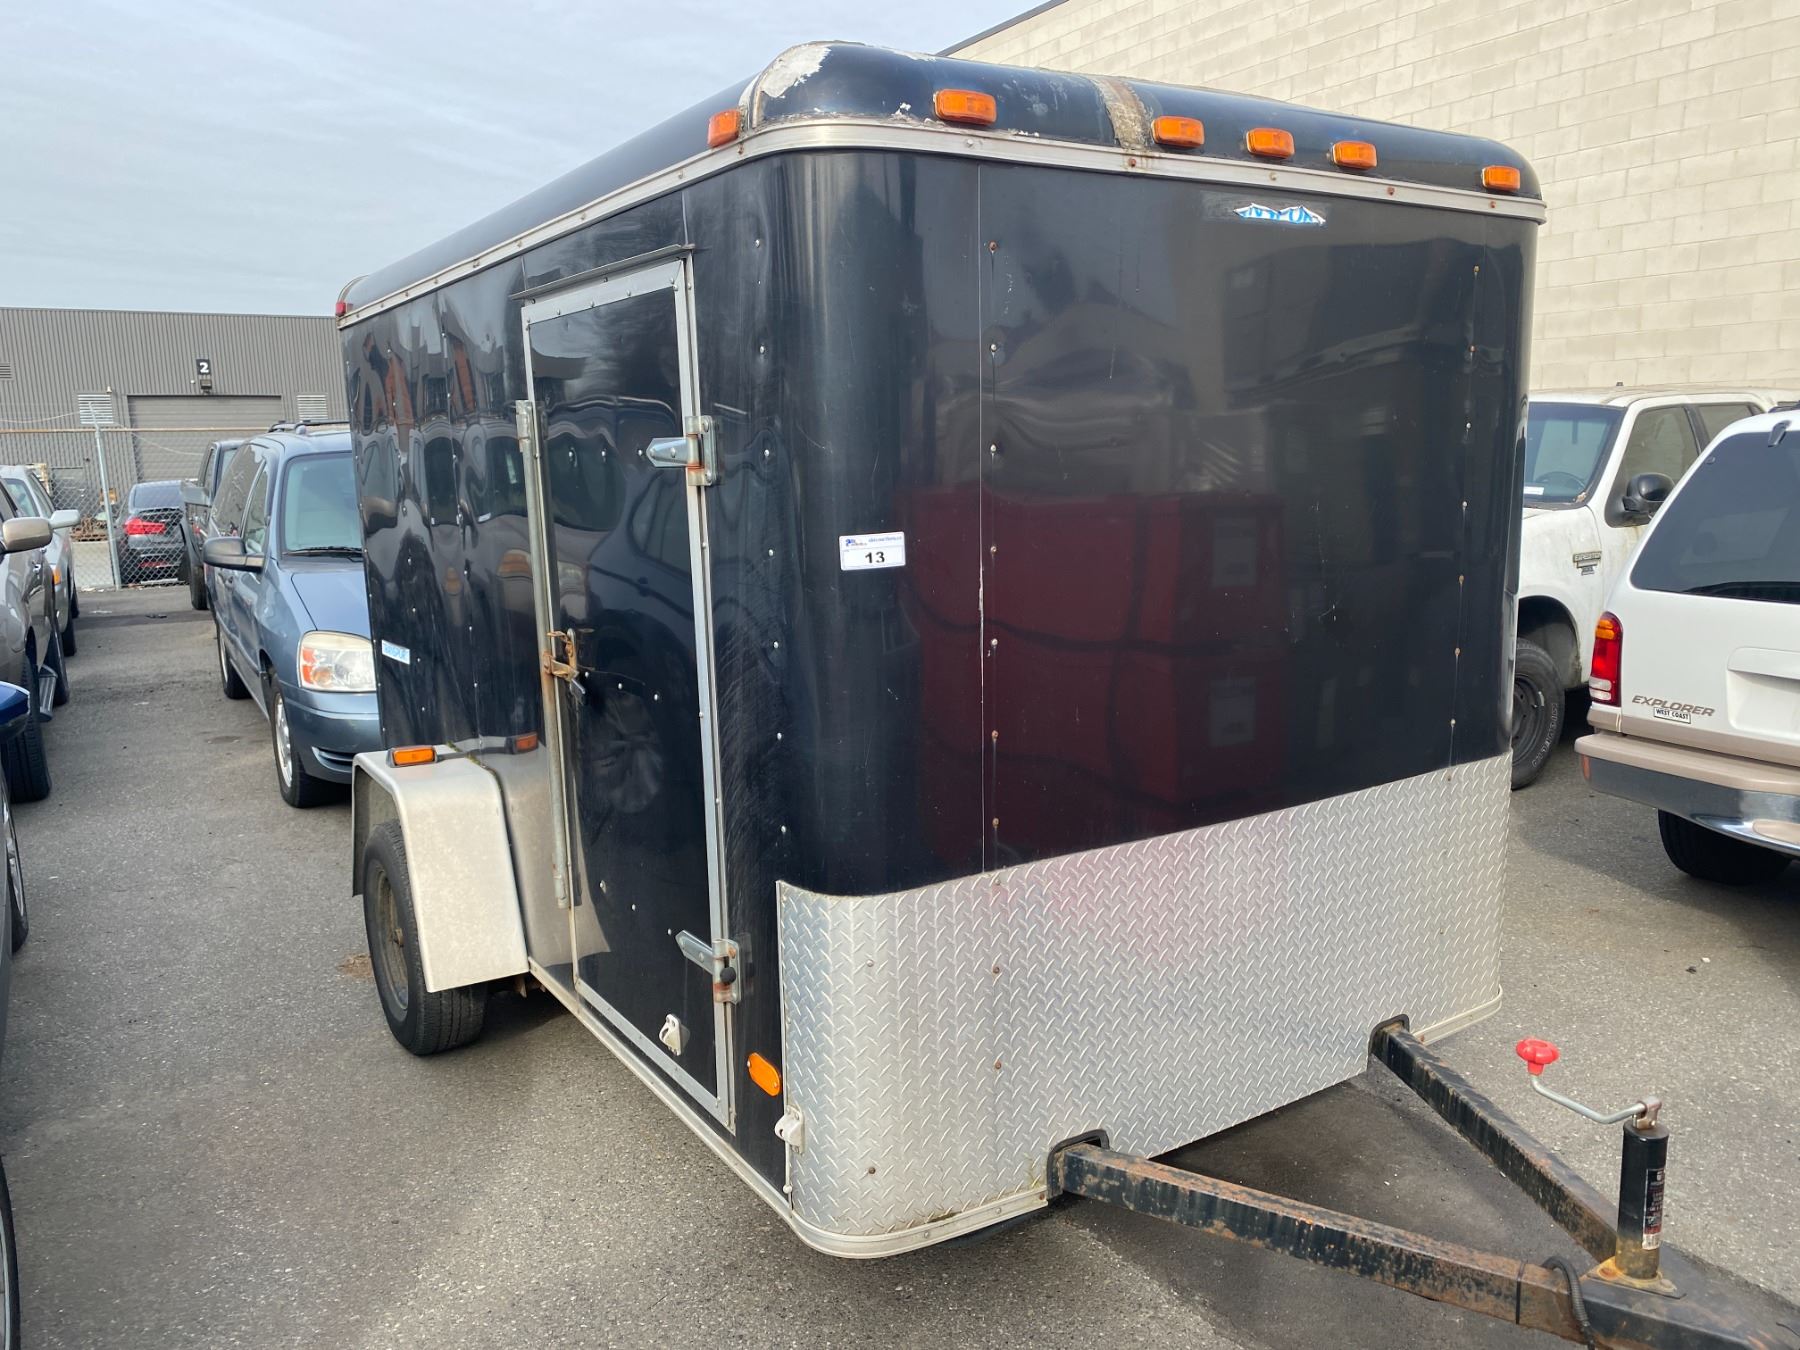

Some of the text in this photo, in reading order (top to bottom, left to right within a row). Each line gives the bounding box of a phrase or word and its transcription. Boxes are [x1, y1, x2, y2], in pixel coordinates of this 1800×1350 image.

[199, 361, 210, 374] 2
[864, 551, 886, 564] 13
[1631, 695, 1716, 717] EXPLORER
[1655, 708, 1689, 720] WEST COAST
